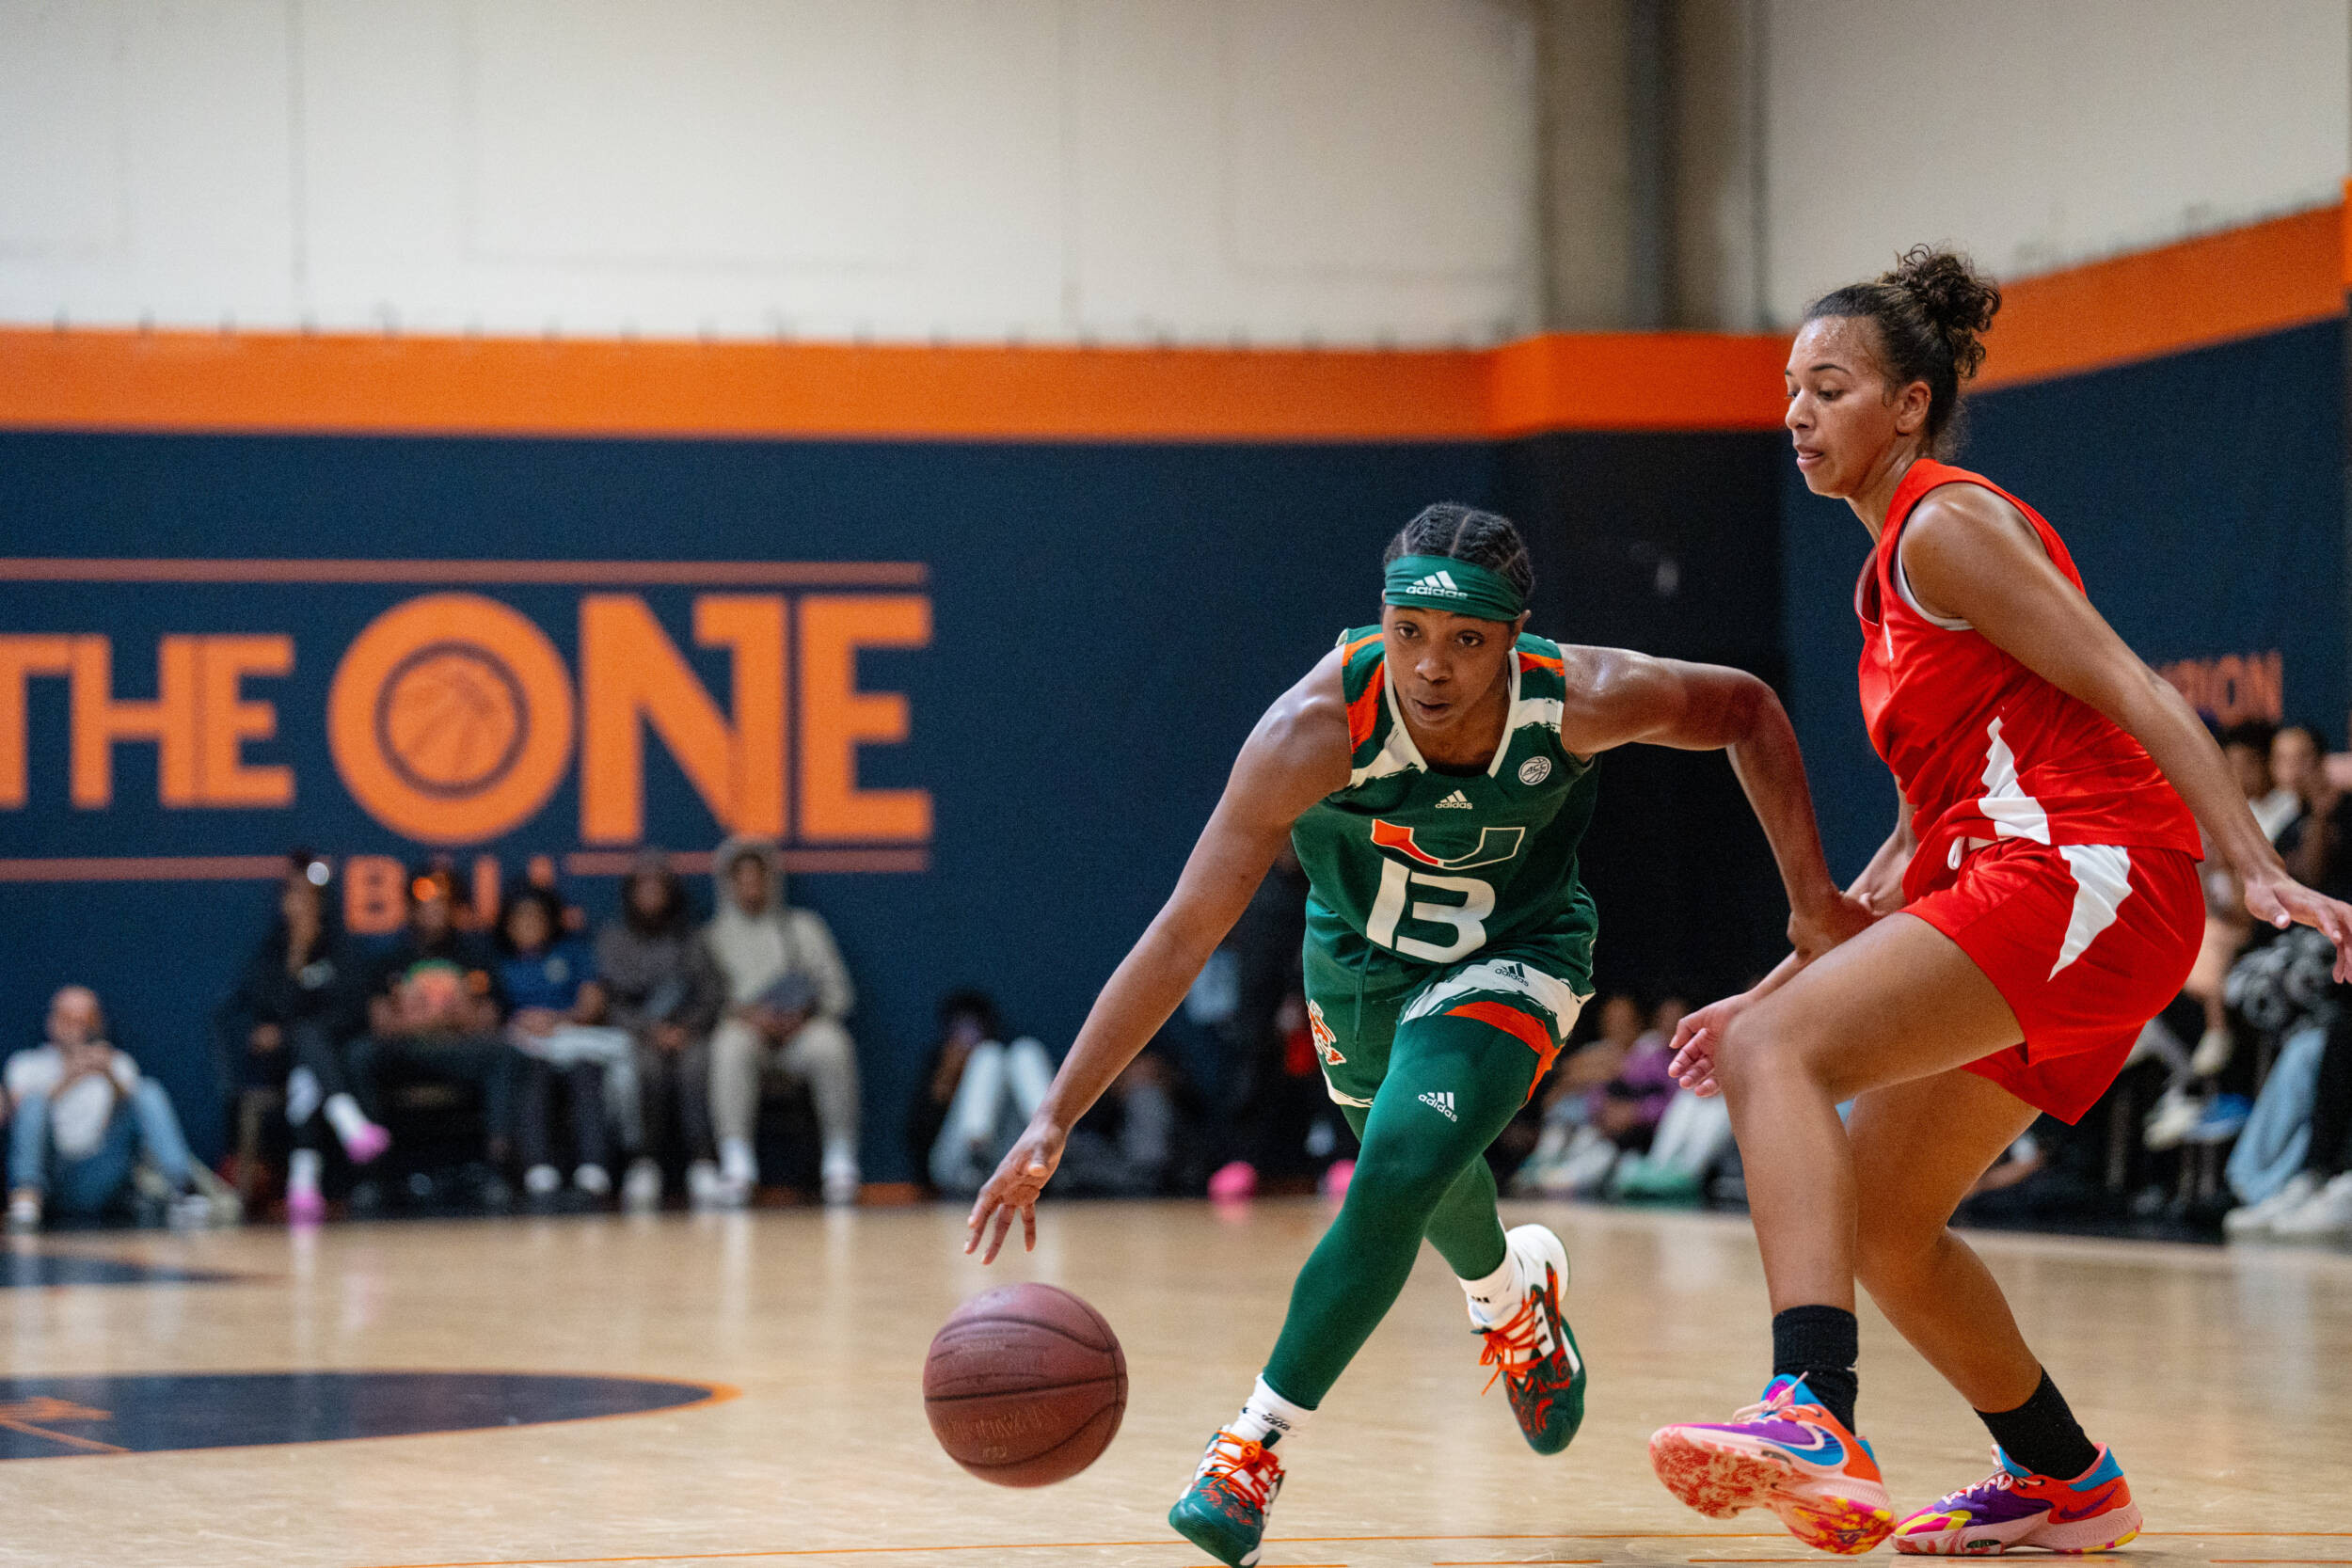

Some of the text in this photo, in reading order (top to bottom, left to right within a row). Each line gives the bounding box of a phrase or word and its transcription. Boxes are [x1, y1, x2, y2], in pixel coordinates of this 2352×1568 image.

[1406, 585, 1469, 598] adidas
[0, 591, 933, 845] THE ONE
[1366, 857, 1496, 964] 13
[1494, 966, 1530, 987] adidas
[1418, 1094, 1458, 1122] adidas
